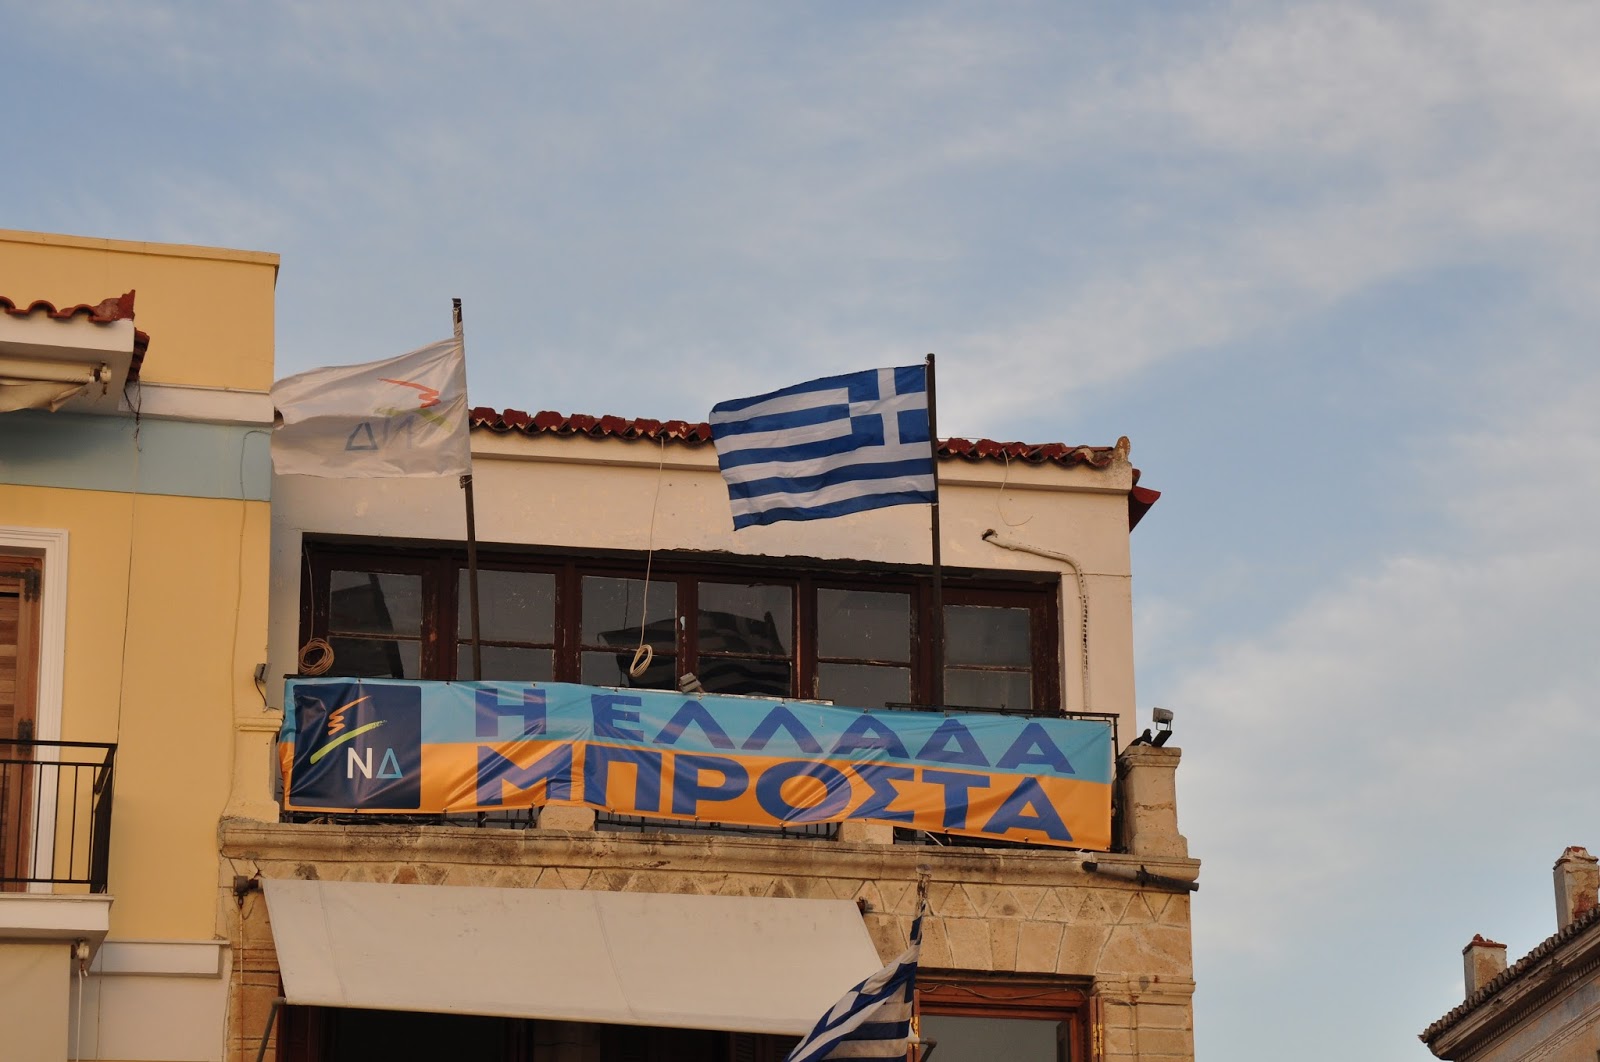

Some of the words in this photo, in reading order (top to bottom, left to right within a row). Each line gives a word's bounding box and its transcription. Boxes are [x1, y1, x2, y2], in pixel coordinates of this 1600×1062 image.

[347, 747, 403, 779] ΝΔ
[475, 688, 546, 737] Η
[591, 693, 1075, 774] ΕΛΛΑΔΑ
[476, 744, 1073, 841] ΜΠΡΟΣΤΑ
